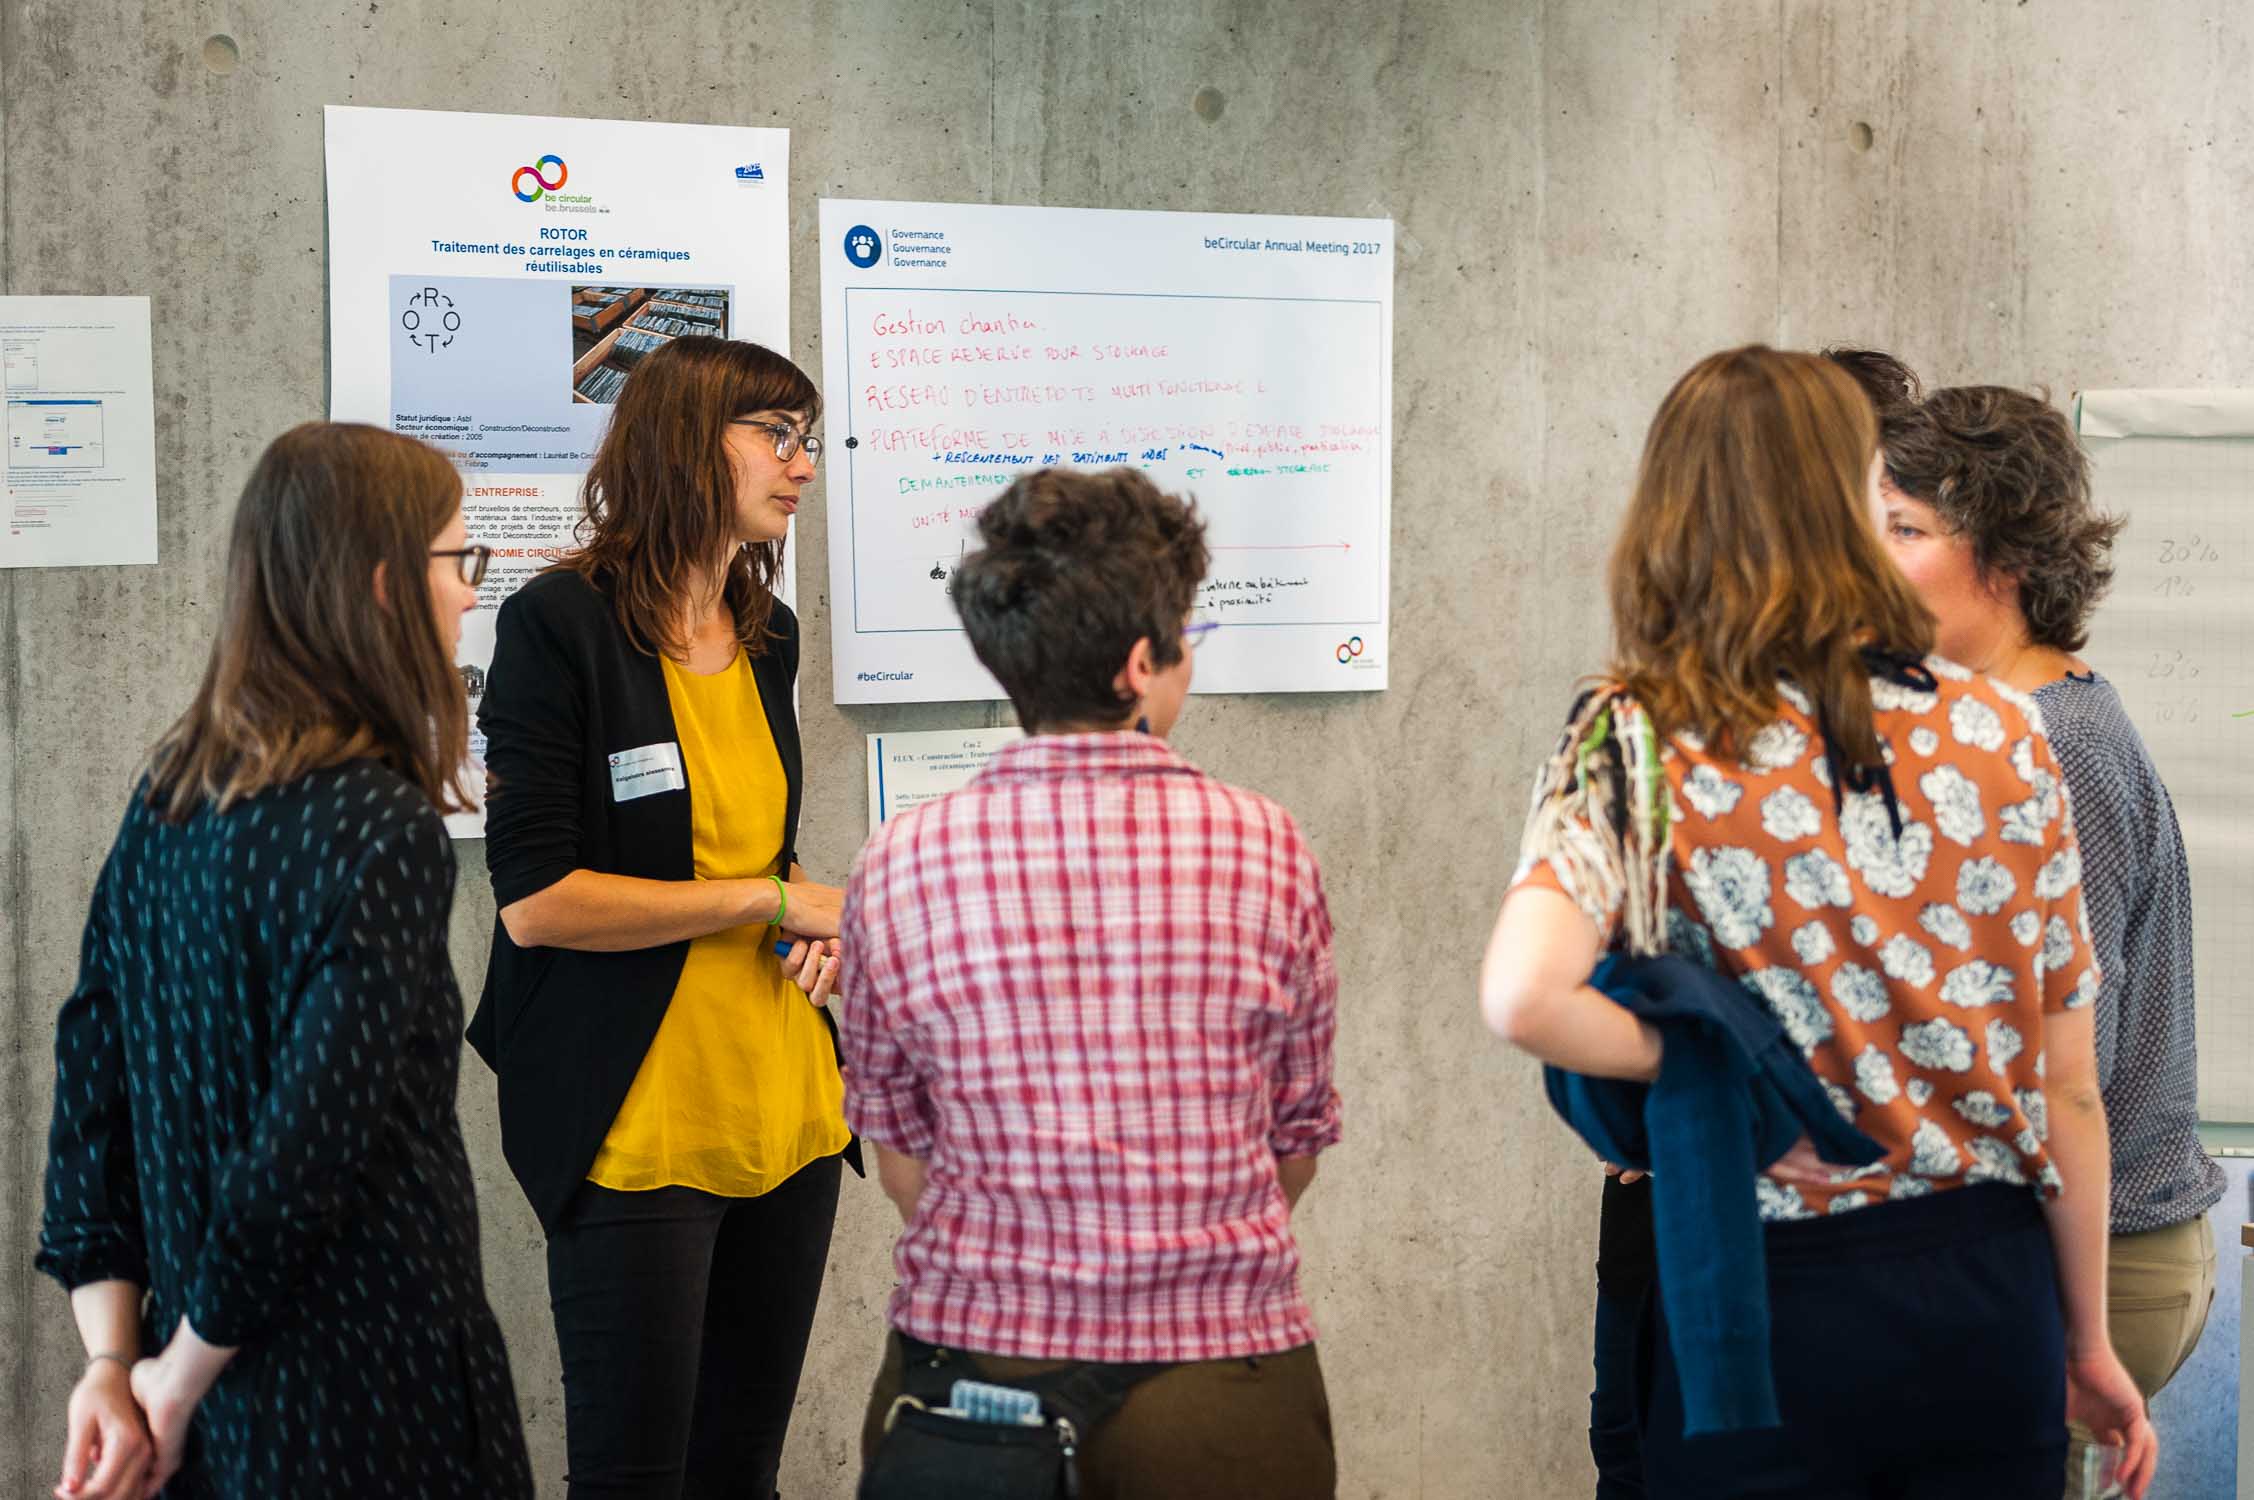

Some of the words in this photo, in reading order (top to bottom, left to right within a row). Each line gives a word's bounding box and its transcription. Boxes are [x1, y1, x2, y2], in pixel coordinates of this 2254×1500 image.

[544, 194, 556, 202] be
[558, 194, 592, 203] circular
[544, 203, 598, 214] be.brussels
[540, 228, 588, 240] ROTOR
[891, 229, 944, 240] Governance
[432, 240, 499, 254] Traitement
[503, 243, 526, 255] des
[529, 245, 596, 260] carrelages
[599, 249, 615, 258] en
[618, 246, 690, 262] céramiques
[892, 243, 951, 254] Gouvernance
[1204, 237, 1261, 251] beCircular
[1264, 239, 1303, 252] Annual
[1306, 241, 1349, 256] Meeting
[1352, 242, 1381, 254] 2017
[526, 260, 603, 274] réutilisables
[893, 257, 947, 268] Governance
[871, 309, 946, 336] Gestion
[870, 346, 943, 369] ESPACE
[419, 415, 451, 423] juridique
[395, 423, 423, 431] Secteur
[425, 424, 469, 432] économique
[870, 424, 991, 452] PLATEFORME
[469, 452, 538, 460] d'accompagnement
[466, 487, 539, 497] L'ENTREPRISE
[478, 505, 511, 513] bruxellois
[522, 506, 562, 514] chercheurs,
[501, 523, 524, 532] projets
[539, 524, 561, 532] design
[857, 671, 913, 681] #beCircular
